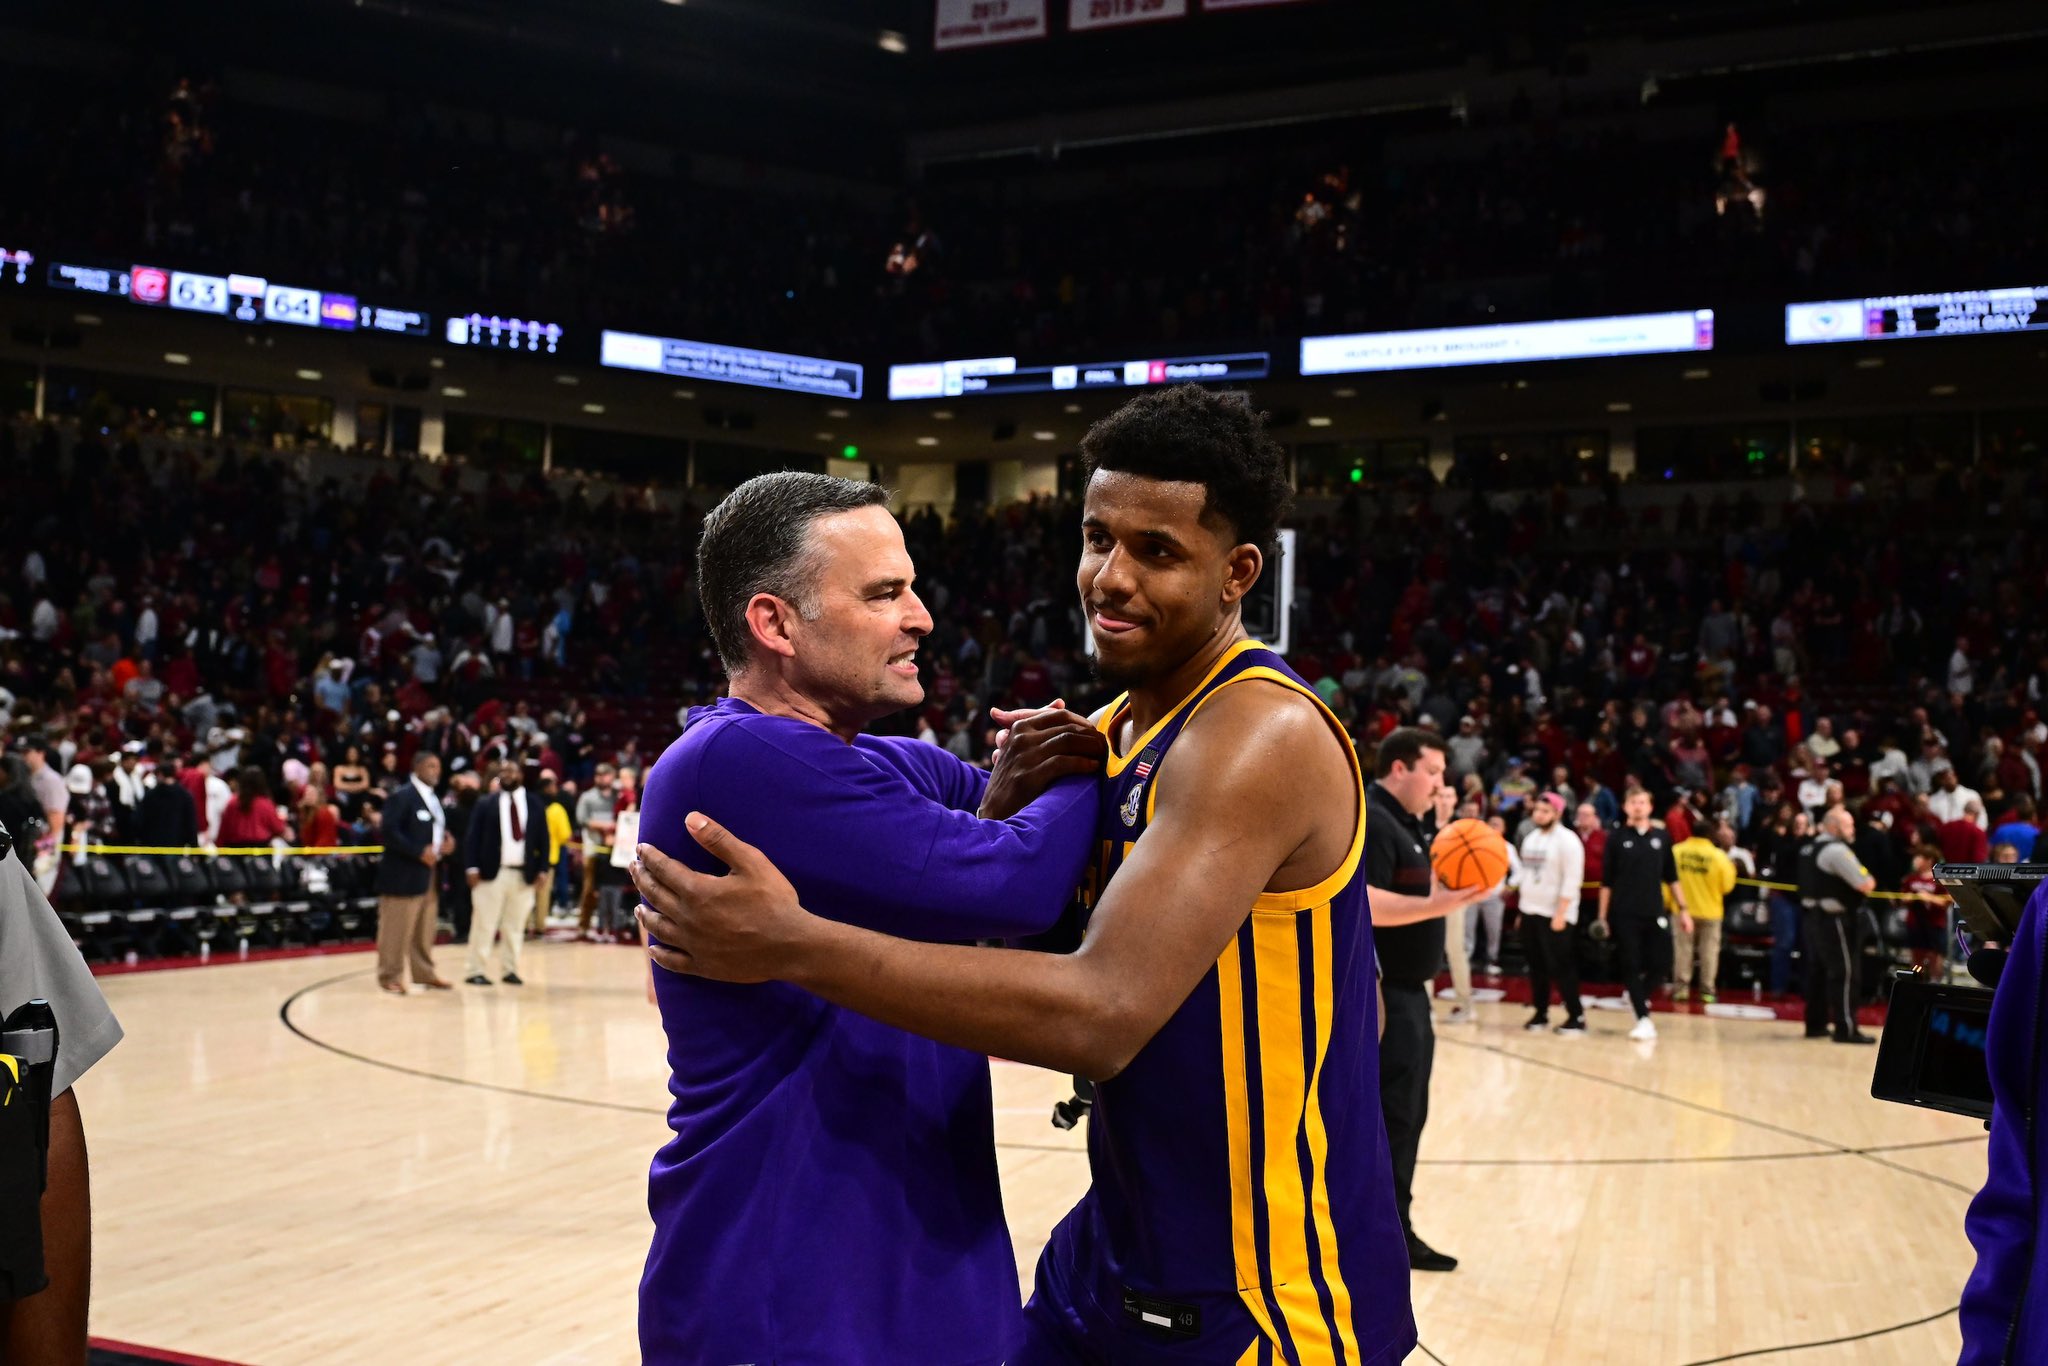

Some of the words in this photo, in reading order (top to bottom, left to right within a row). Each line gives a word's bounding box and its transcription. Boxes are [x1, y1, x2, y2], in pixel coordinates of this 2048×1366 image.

[177, 278, 218, 305] 63
[273, 293, 312, 319] 64
[1178, 1312, 1193, 1326] 48
